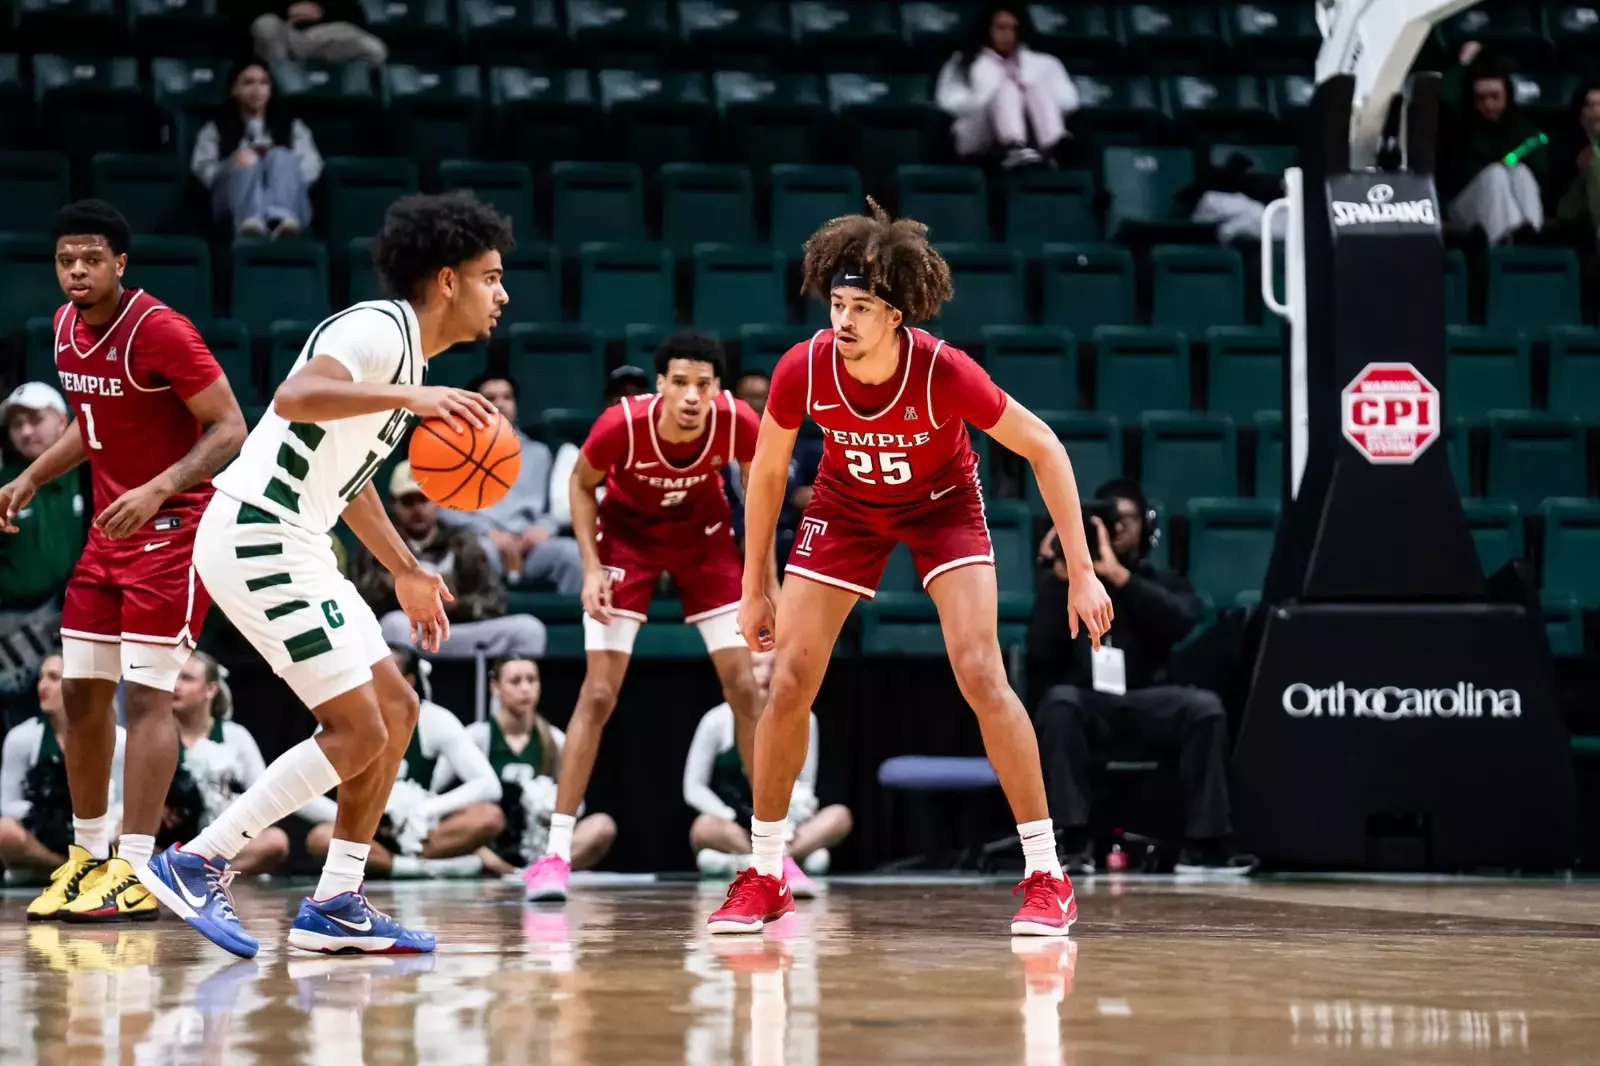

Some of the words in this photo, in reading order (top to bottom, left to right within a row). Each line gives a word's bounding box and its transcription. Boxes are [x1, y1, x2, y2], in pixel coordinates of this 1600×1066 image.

[1332, 198, 1435, 226] SPALDING
[58, 371, 124, 396] TEMPLE
[81, 402, 103, 450] 1
[1352, 398, 1429, 426] CPI
[821, 427, 930, 448] TEMPLE
[845, 449, 912, 485] 25
[796, 516, 828, 557] T
[320, 599, 345, 629] C
[1282, 680, 1522, 721] OrthoCarolina
